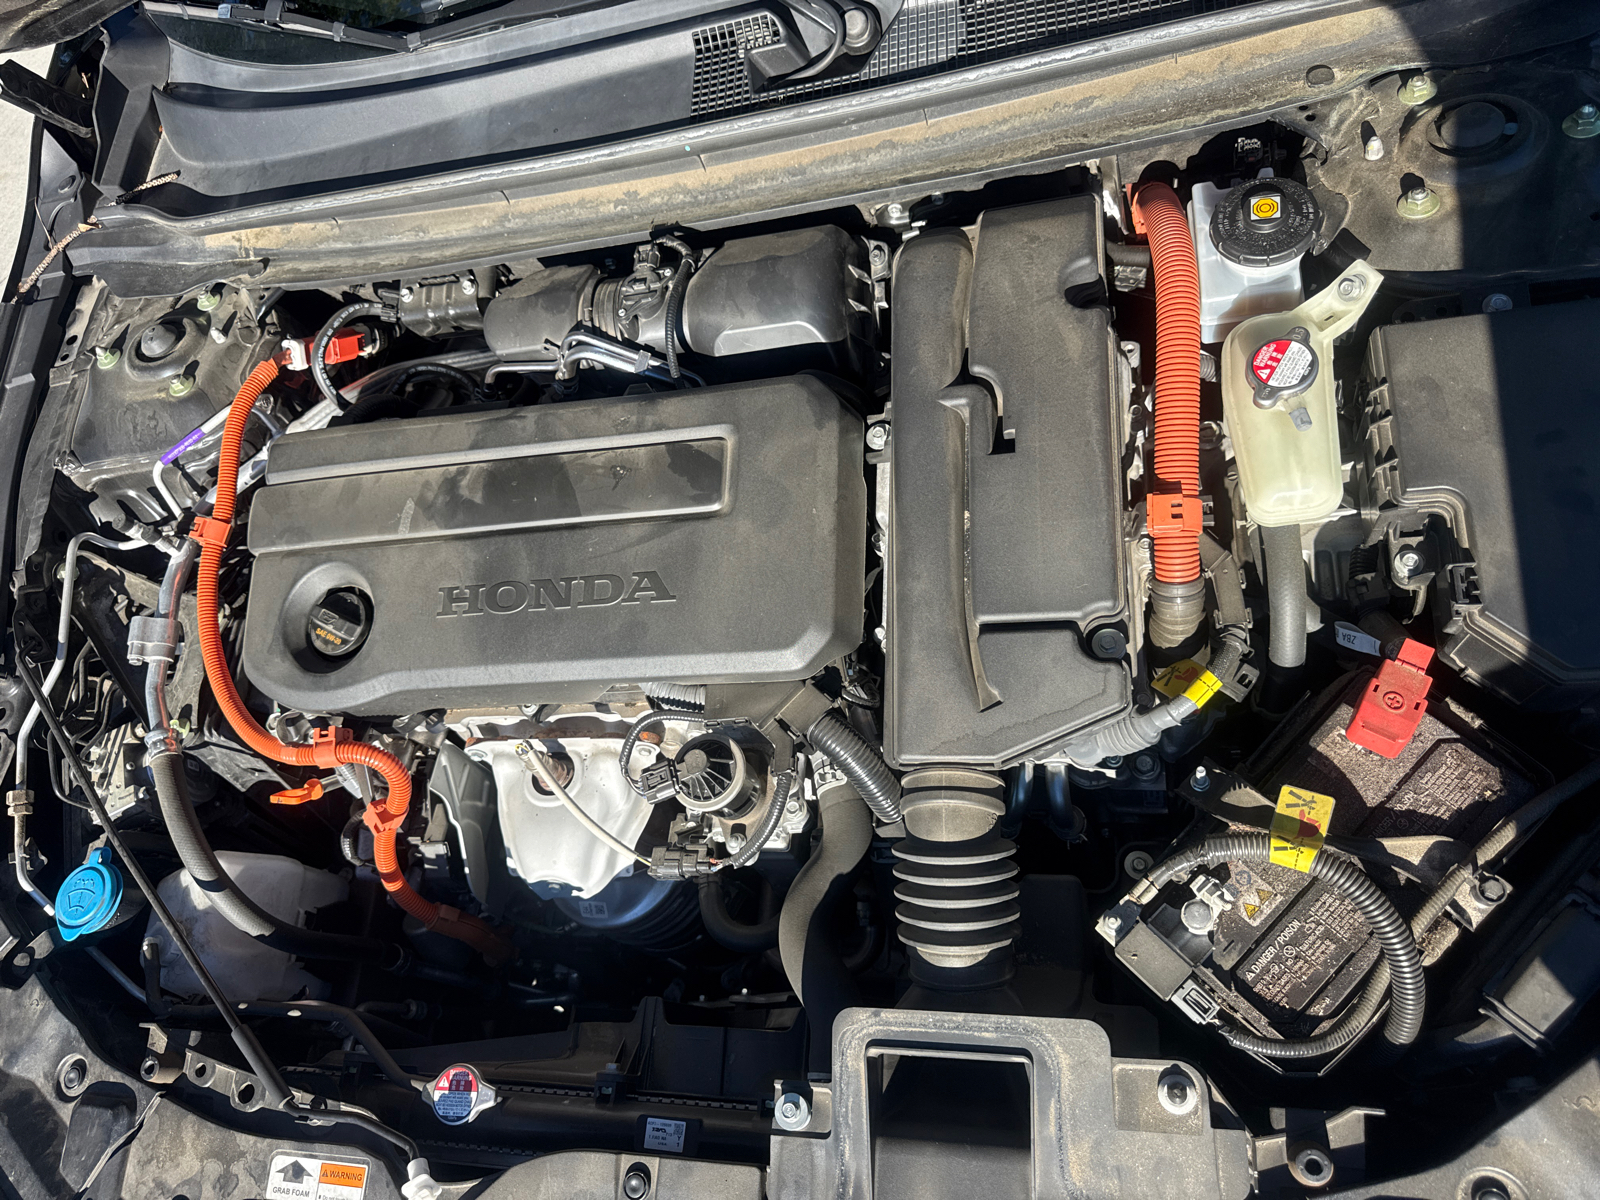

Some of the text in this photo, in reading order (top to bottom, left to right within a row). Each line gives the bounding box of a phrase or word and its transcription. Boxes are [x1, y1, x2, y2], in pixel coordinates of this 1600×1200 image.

[1253, 346, 1268, 366] DANGER
[1259, 344, 1276, 367] WARNING
[436, 570, 677, 618] HONDA
[316, 628, 328, 638] SAE
[1342, 632, 1357, 645] ZBA
[1250, 945, 1277, 973] DANGER
[1276, 918, 1301, 944] POISON
[330, 1170, 362, 1182] WARNING
[272, 1186, 310, 1198] GRAB FOAM
